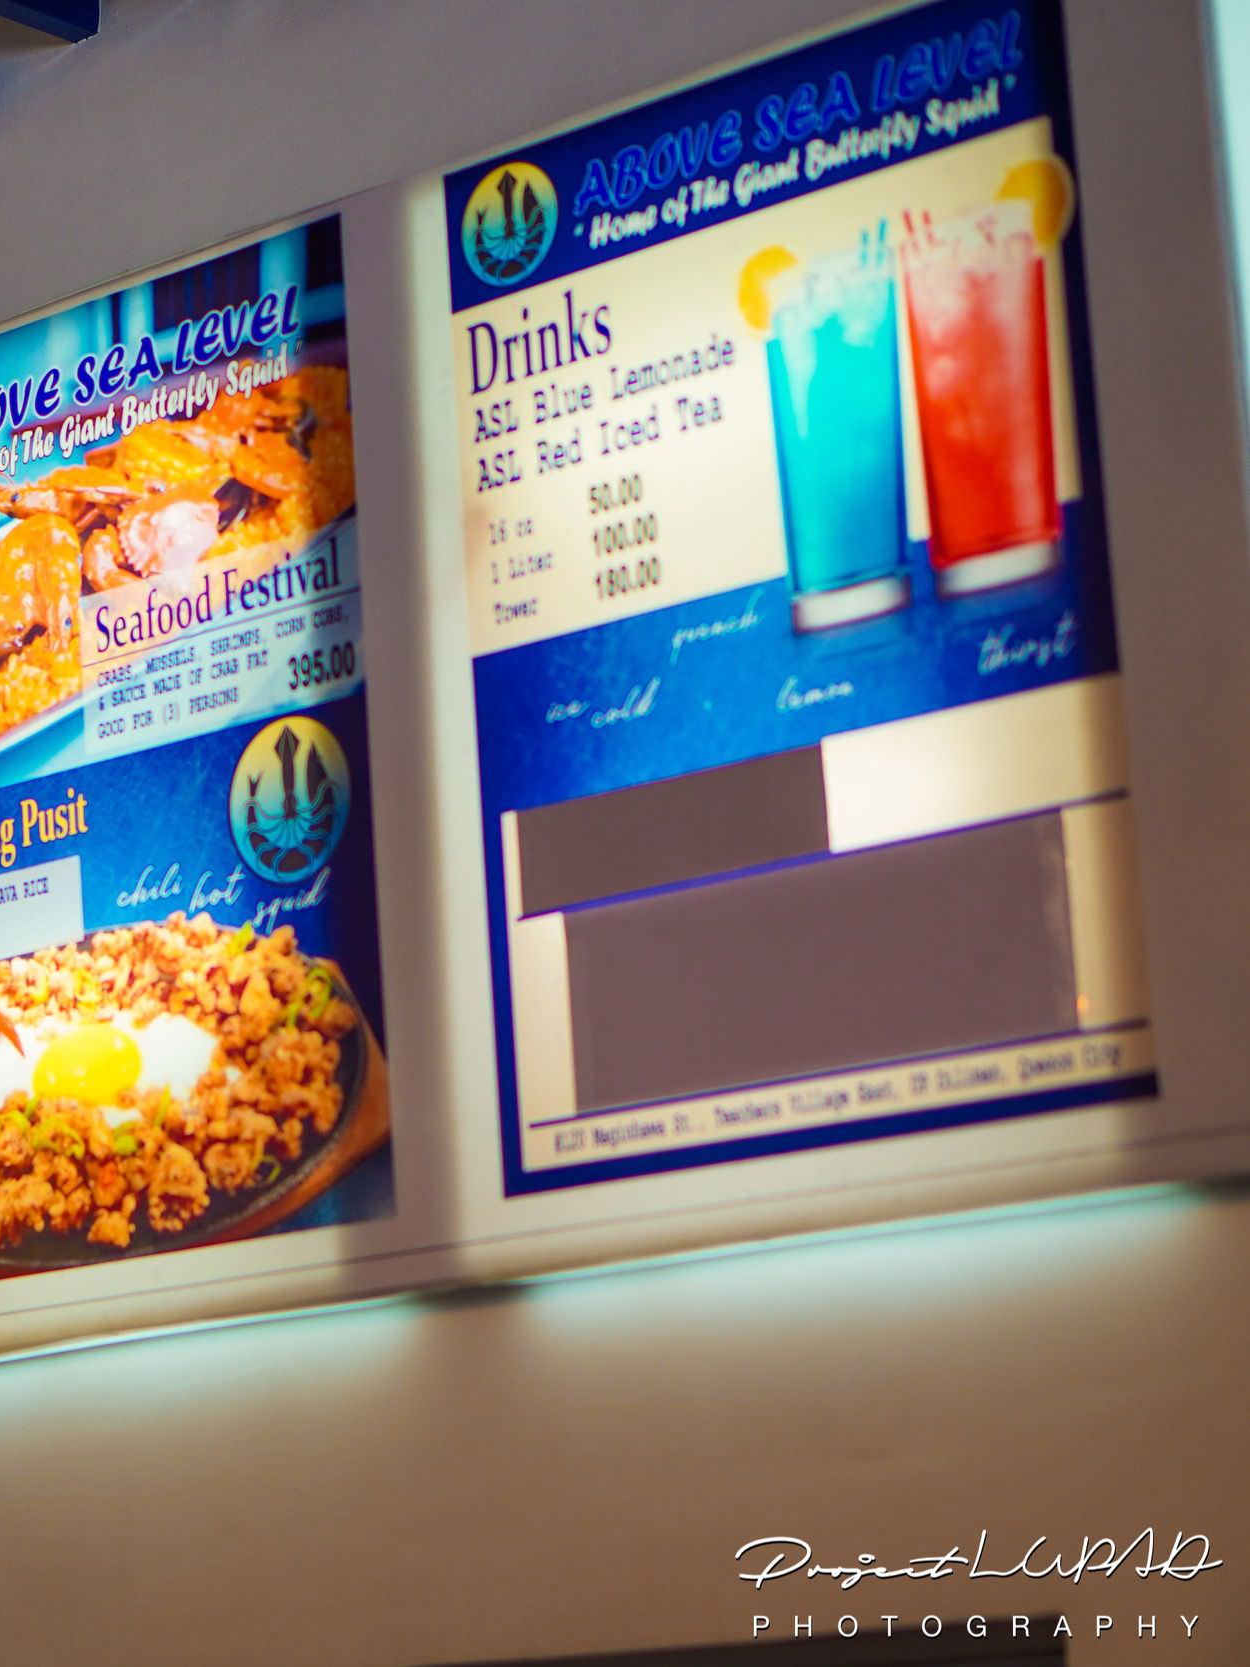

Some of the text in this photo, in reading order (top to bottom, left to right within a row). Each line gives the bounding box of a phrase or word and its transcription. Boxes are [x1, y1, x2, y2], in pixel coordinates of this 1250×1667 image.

[574, 10, 1024, 215] ABOVE SEA LEVEL
[661, 190, 691, 226] of
[692, 174, 730, 214] The
[734, 152, 800, 206] Giant
[805, 110, 920, 181] Butterfly
[74, 335, 163, 404] SEA
[174, 285, 300, 374] LEVEL
[467, 290, 612, 395] Drinks
[21, 427, 54, 463] The
[59, 411, 115, 458] Giant
[121, 372, 219, 436] Butterfly
[474, 333, 736, 444] ASL Blue Lemonade
[477, 397, 723, 492] ASL Red Iced Tea
[589, 473, 643, 515] 50.00
[593, 513, 657, 556] 100.00
[96, 537, 340, 653] Seafood Festival
[595, 556, 660, 600] 180.00
[112, 684, 146, 708] SAUCE
[154, 674, 181, 696] MADE
[190, 668, 203, 686] OF
[211, 659, 239, 681] CRAB
[247, 650, 268, 671] FAT
[288, 642, 355, 690] 395.00
[98, 719, 124, 738] GOOD
[133, 710, 153, 731] FOR
[190, 687, 239, 714] PERSONS
[591, 678, 661, 728] cold
[20, 787, 88, 848] Pusit
[24, 877, 49, 898] RICE
[116, 863, 331, 934] chili hot squid
